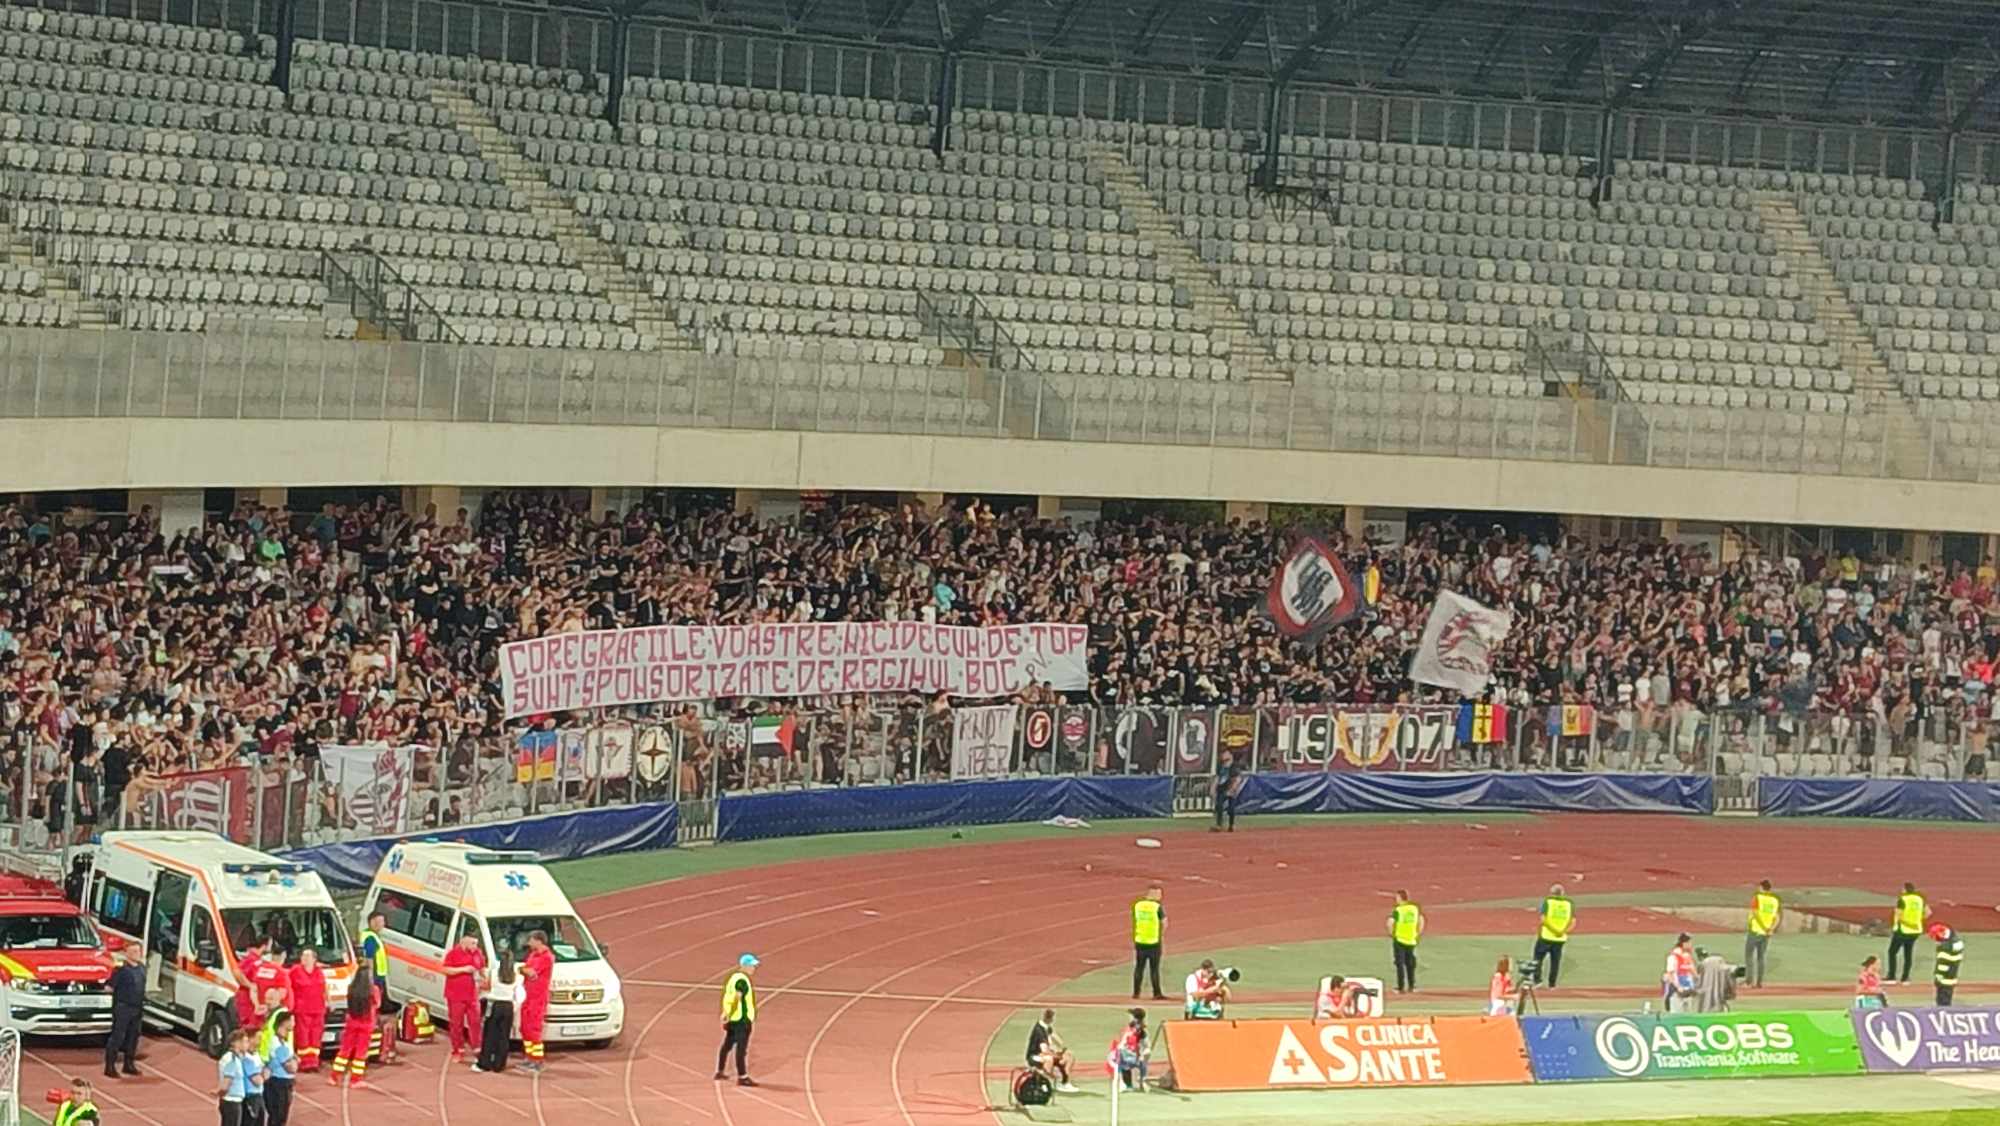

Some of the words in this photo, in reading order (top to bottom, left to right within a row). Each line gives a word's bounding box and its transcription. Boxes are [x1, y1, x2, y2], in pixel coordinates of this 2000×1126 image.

[507, 628, 706, 679] COREGRAFIILE
[987, 627, 1023, 658] DE
[1029, 625, 1088, 655] TOP
[797, 660, 834, 693] DE
[965, 659, 1019, 695] BOC
[1355, 1023, 1438, 1046] CLINICA
[1651, 1022, 1793, 1051] AROBS
[1928, 1010, 1990, 1036] VISIT
[1320, 1024, 1446, 1082] SANTE
[1655, 1051, 1736, 1068] Transilvania
[1738, 1051, 1800, 1067] Software
[1925, 1040, 1961, 1063] The
